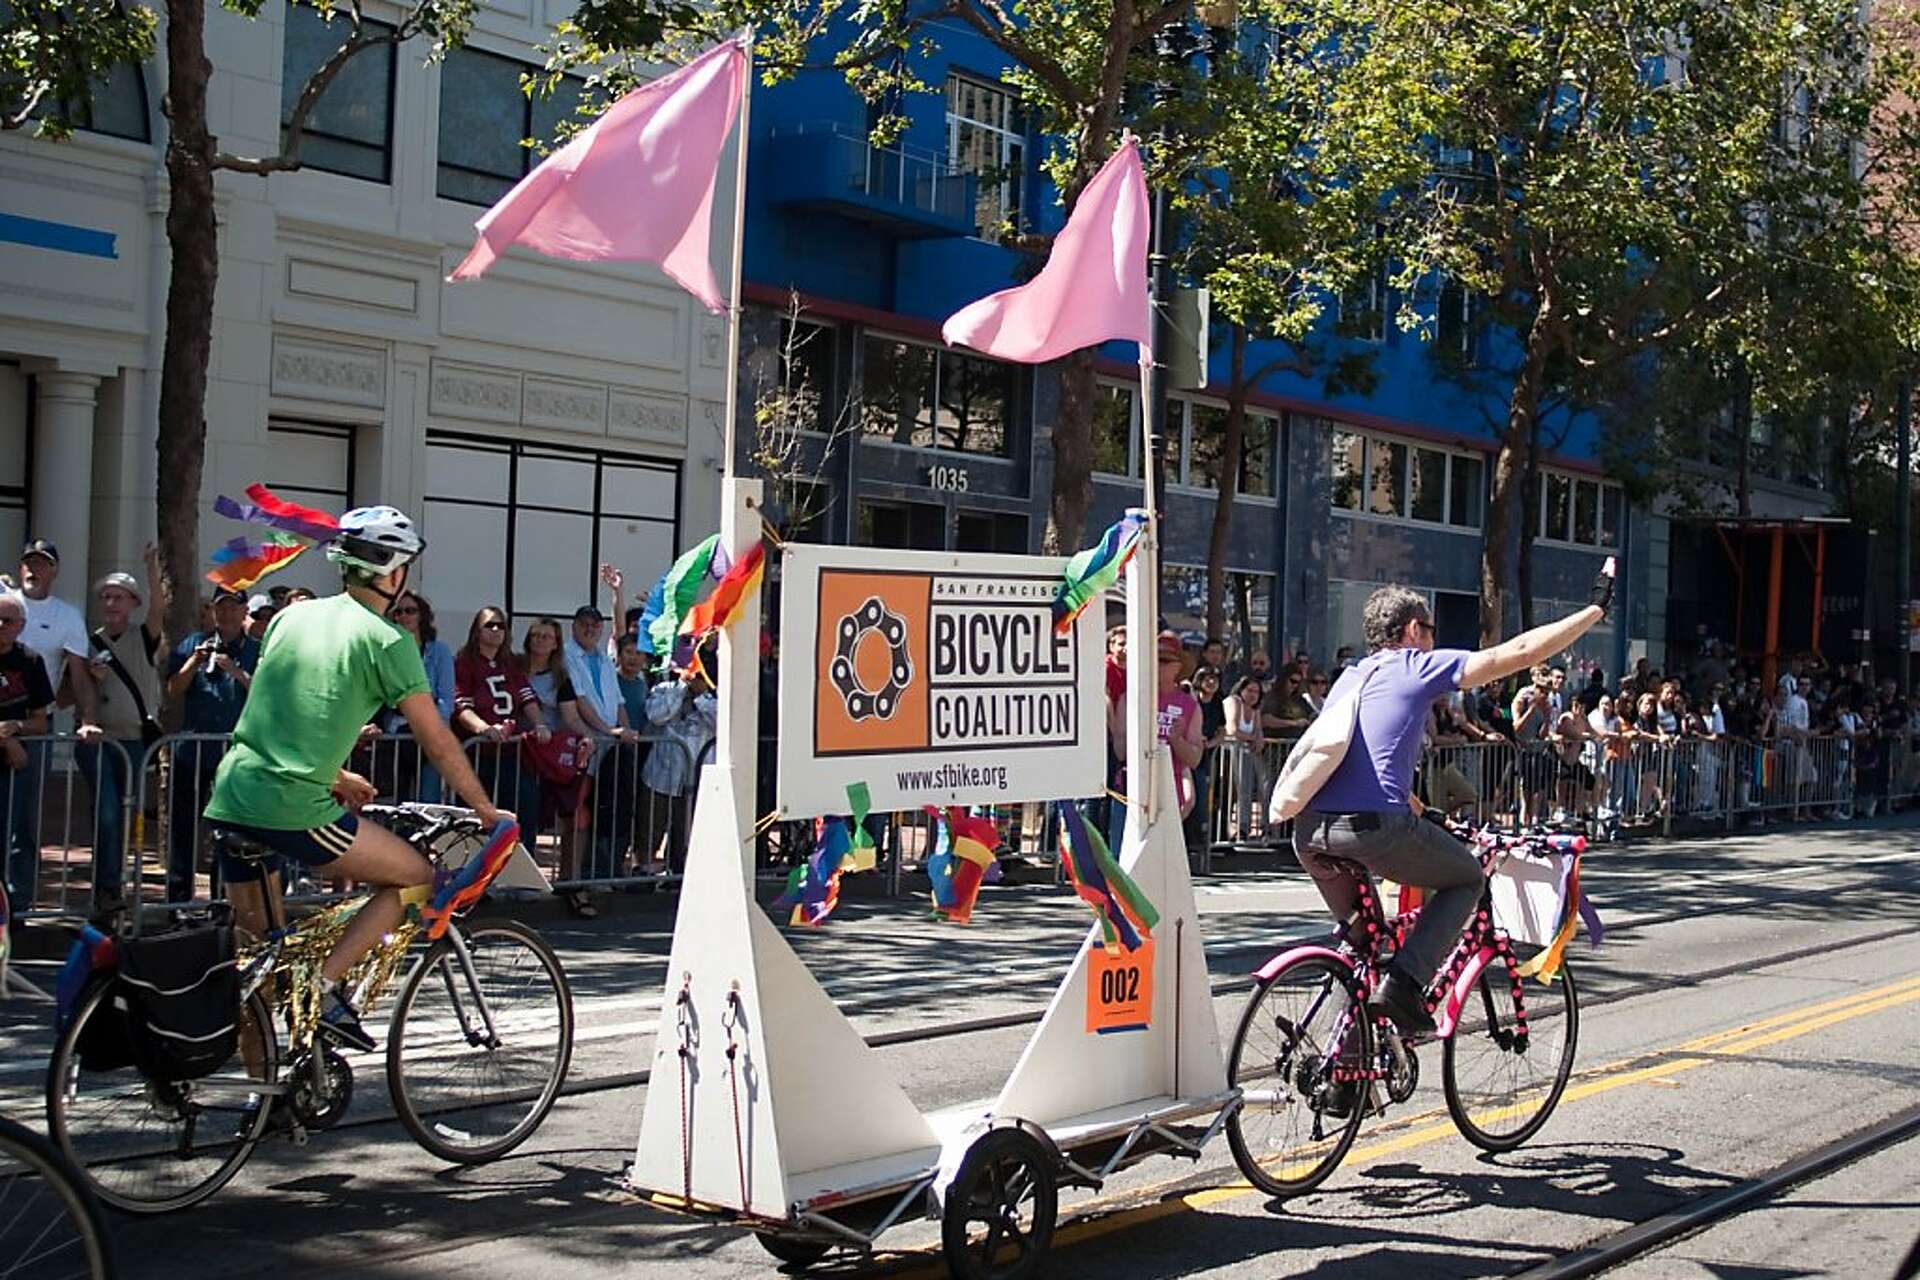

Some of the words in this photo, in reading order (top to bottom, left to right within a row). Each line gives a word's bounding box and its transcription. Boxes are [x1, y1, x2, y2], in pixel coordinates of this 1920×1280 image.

[928, 465, 968, 492] 1035
[937, 583, 968, 594] SAN
[976, 584, 1060, 597] FRANCISC
[935, 613, 1070, 675] BICYCLE
[486, 674, 514, 716] 5
[936, 693, 1070, 739] COALITION
[897, 763, 1008, 790] www.sfbike.org
[1101, 967, 1140, 1005] 002
